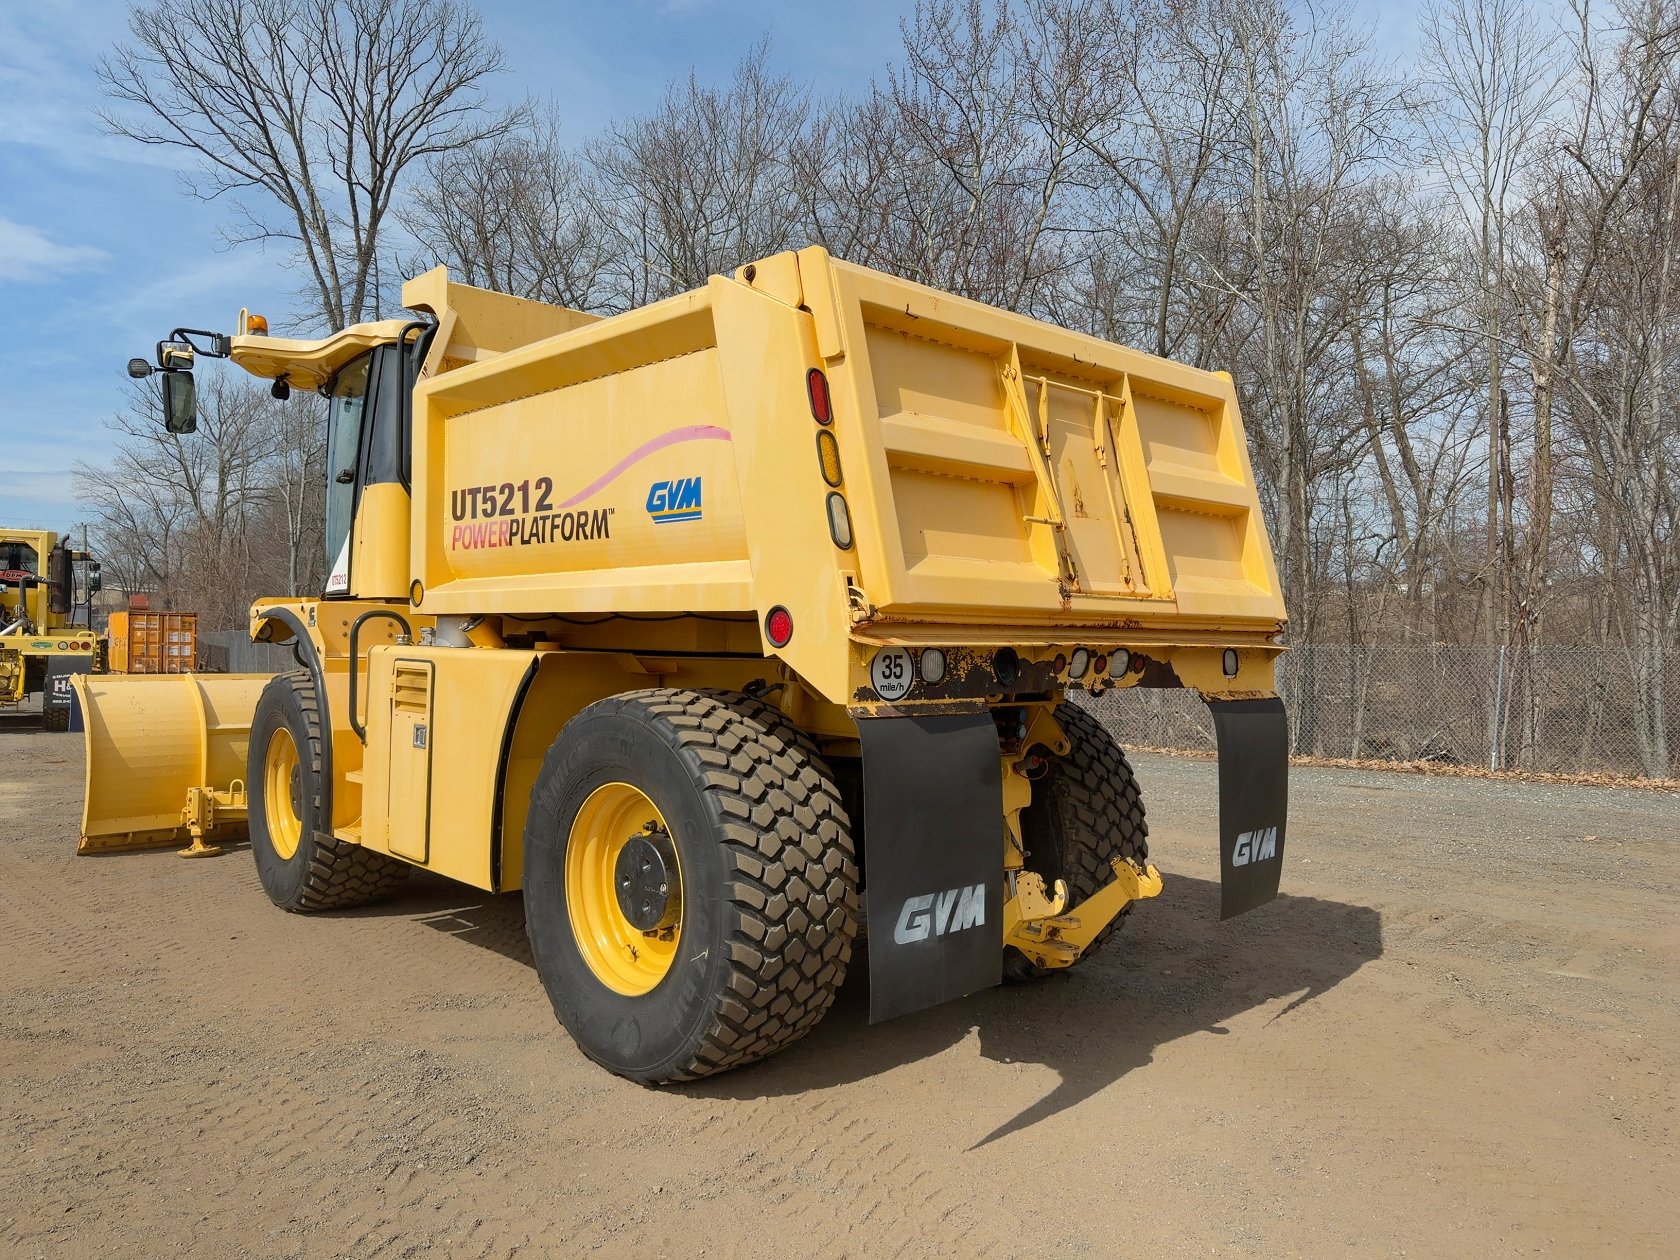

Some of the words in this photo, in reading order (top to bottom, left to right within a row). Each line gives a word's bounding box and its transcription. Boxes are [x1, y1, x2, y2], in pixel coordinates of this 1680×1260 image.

[452, 477, 553, 521] UT5212
[646, 476, 702, 512] GVM
[882, 655, 904, 679] 35
[880, 683, 904, 691] mile/h
[1232, 826, 1278, 867] GVM
[894, 883, 985, 945] GVM
